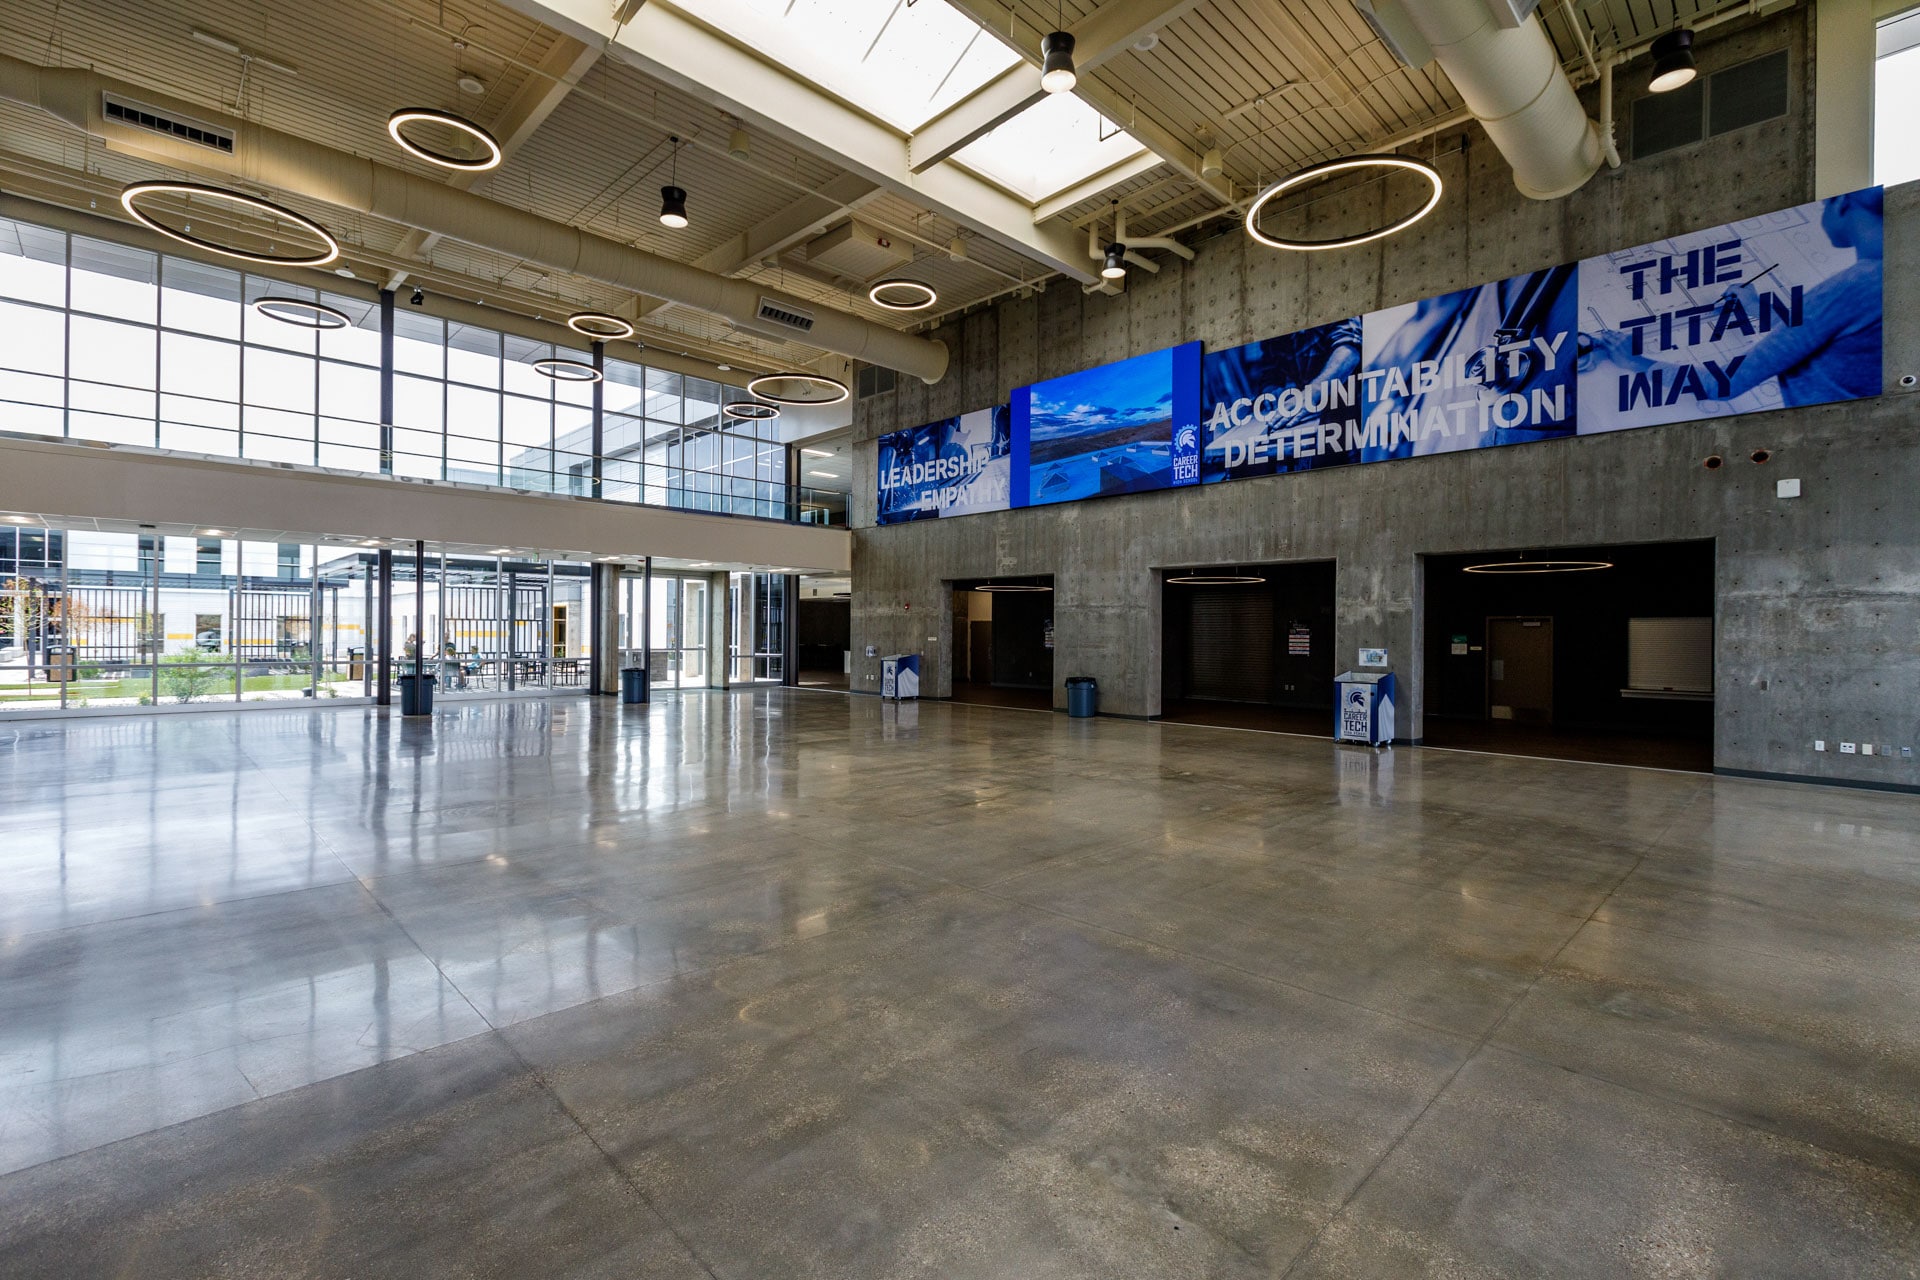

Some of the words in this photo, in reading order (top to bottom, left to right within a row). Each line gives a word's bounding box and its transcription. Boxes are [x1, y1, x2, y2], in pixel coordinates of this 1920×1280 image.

[1620, 239, 1742, 301] THE
[1620, 285, 1803, 356] TITAN
[1209, 330, 1568, 432] ACCOUNTABILITY
[1619, 355, 1747, 412] WAY
[1224, 384, 1566, 469] DETERMINATION
[881, 450, 989, 490] LEADERSHIP
[1173, 455, 1198, 467] CAREER
[1173, 464, 1198, 480] TECH
[921, 477, 1006, 512] EMPATHY
[1344, 712, 1367, 721] CAREER
[1344, 720, 1367, 732] TECH
